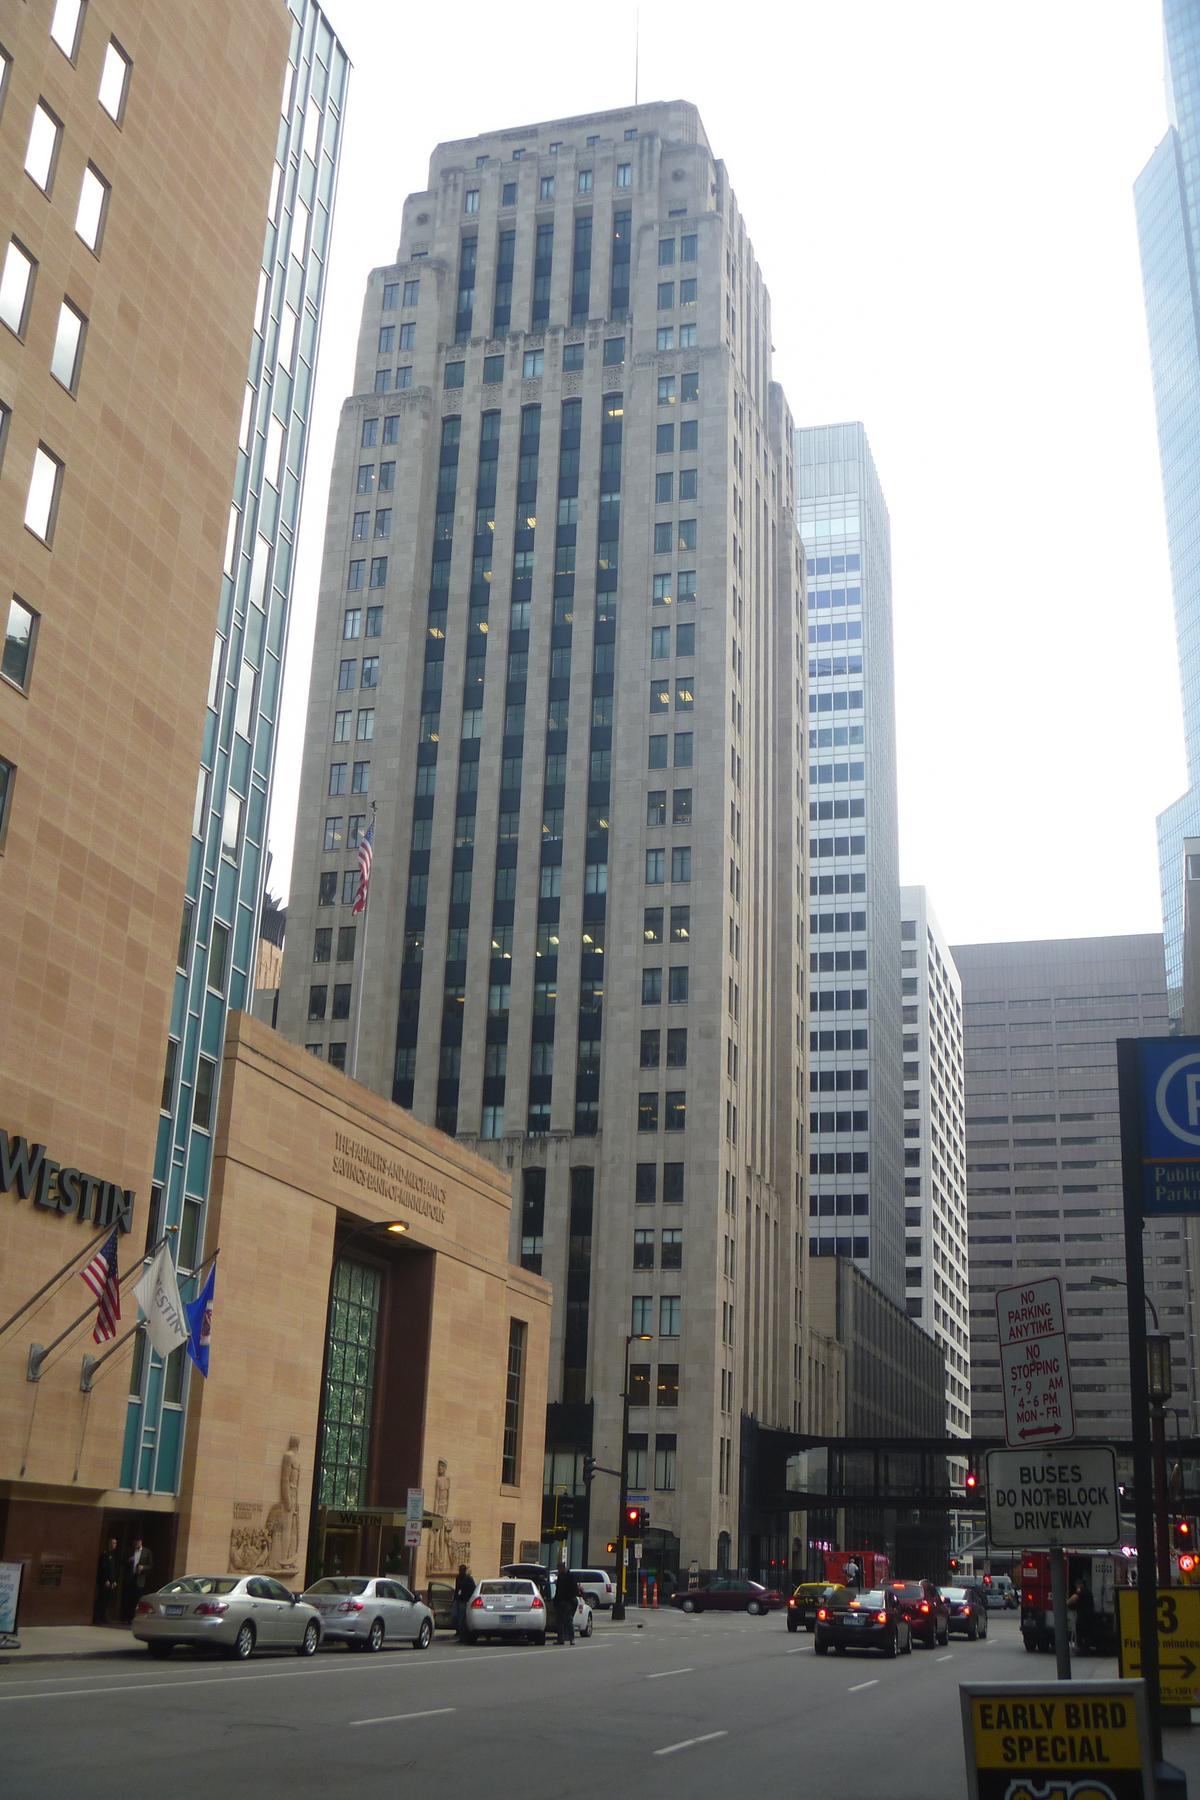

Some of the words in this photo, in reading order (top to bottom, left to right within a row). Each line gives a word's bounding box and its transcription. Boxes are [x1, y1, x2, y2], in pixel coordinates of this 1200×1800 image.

[0, 1128, 136, 1234] WESTIN
[1020, 1290, 1035, 1305] NO
[1008, 1302, 1051, 1324] PARKING
[1008, 1318, 1055, 1341] ANYTIME
[1025, 1344, 1040, 1360] NO
[1010, 1359, 1060, 1381] STOPPING
[1048, 1377, 1063, 1391] AM
[1043, 1392, 1057, 1406] PM
[1019, 1465, 1082, 1484] BUSES
[996, 1489, 1017, 1507] DO
[1021, 1488, 1051, 1507] NOT
[1055, 1486, 1109, 1506] BLOCK
[1014, 1510, 1092, 1530] DRIVEWAY
[979, 1702, 1056, 1730] EARLY
[1064, 1702, 1127, 1730] BIRD
[1001, 1735, 1111, 1763] SPECIAL
